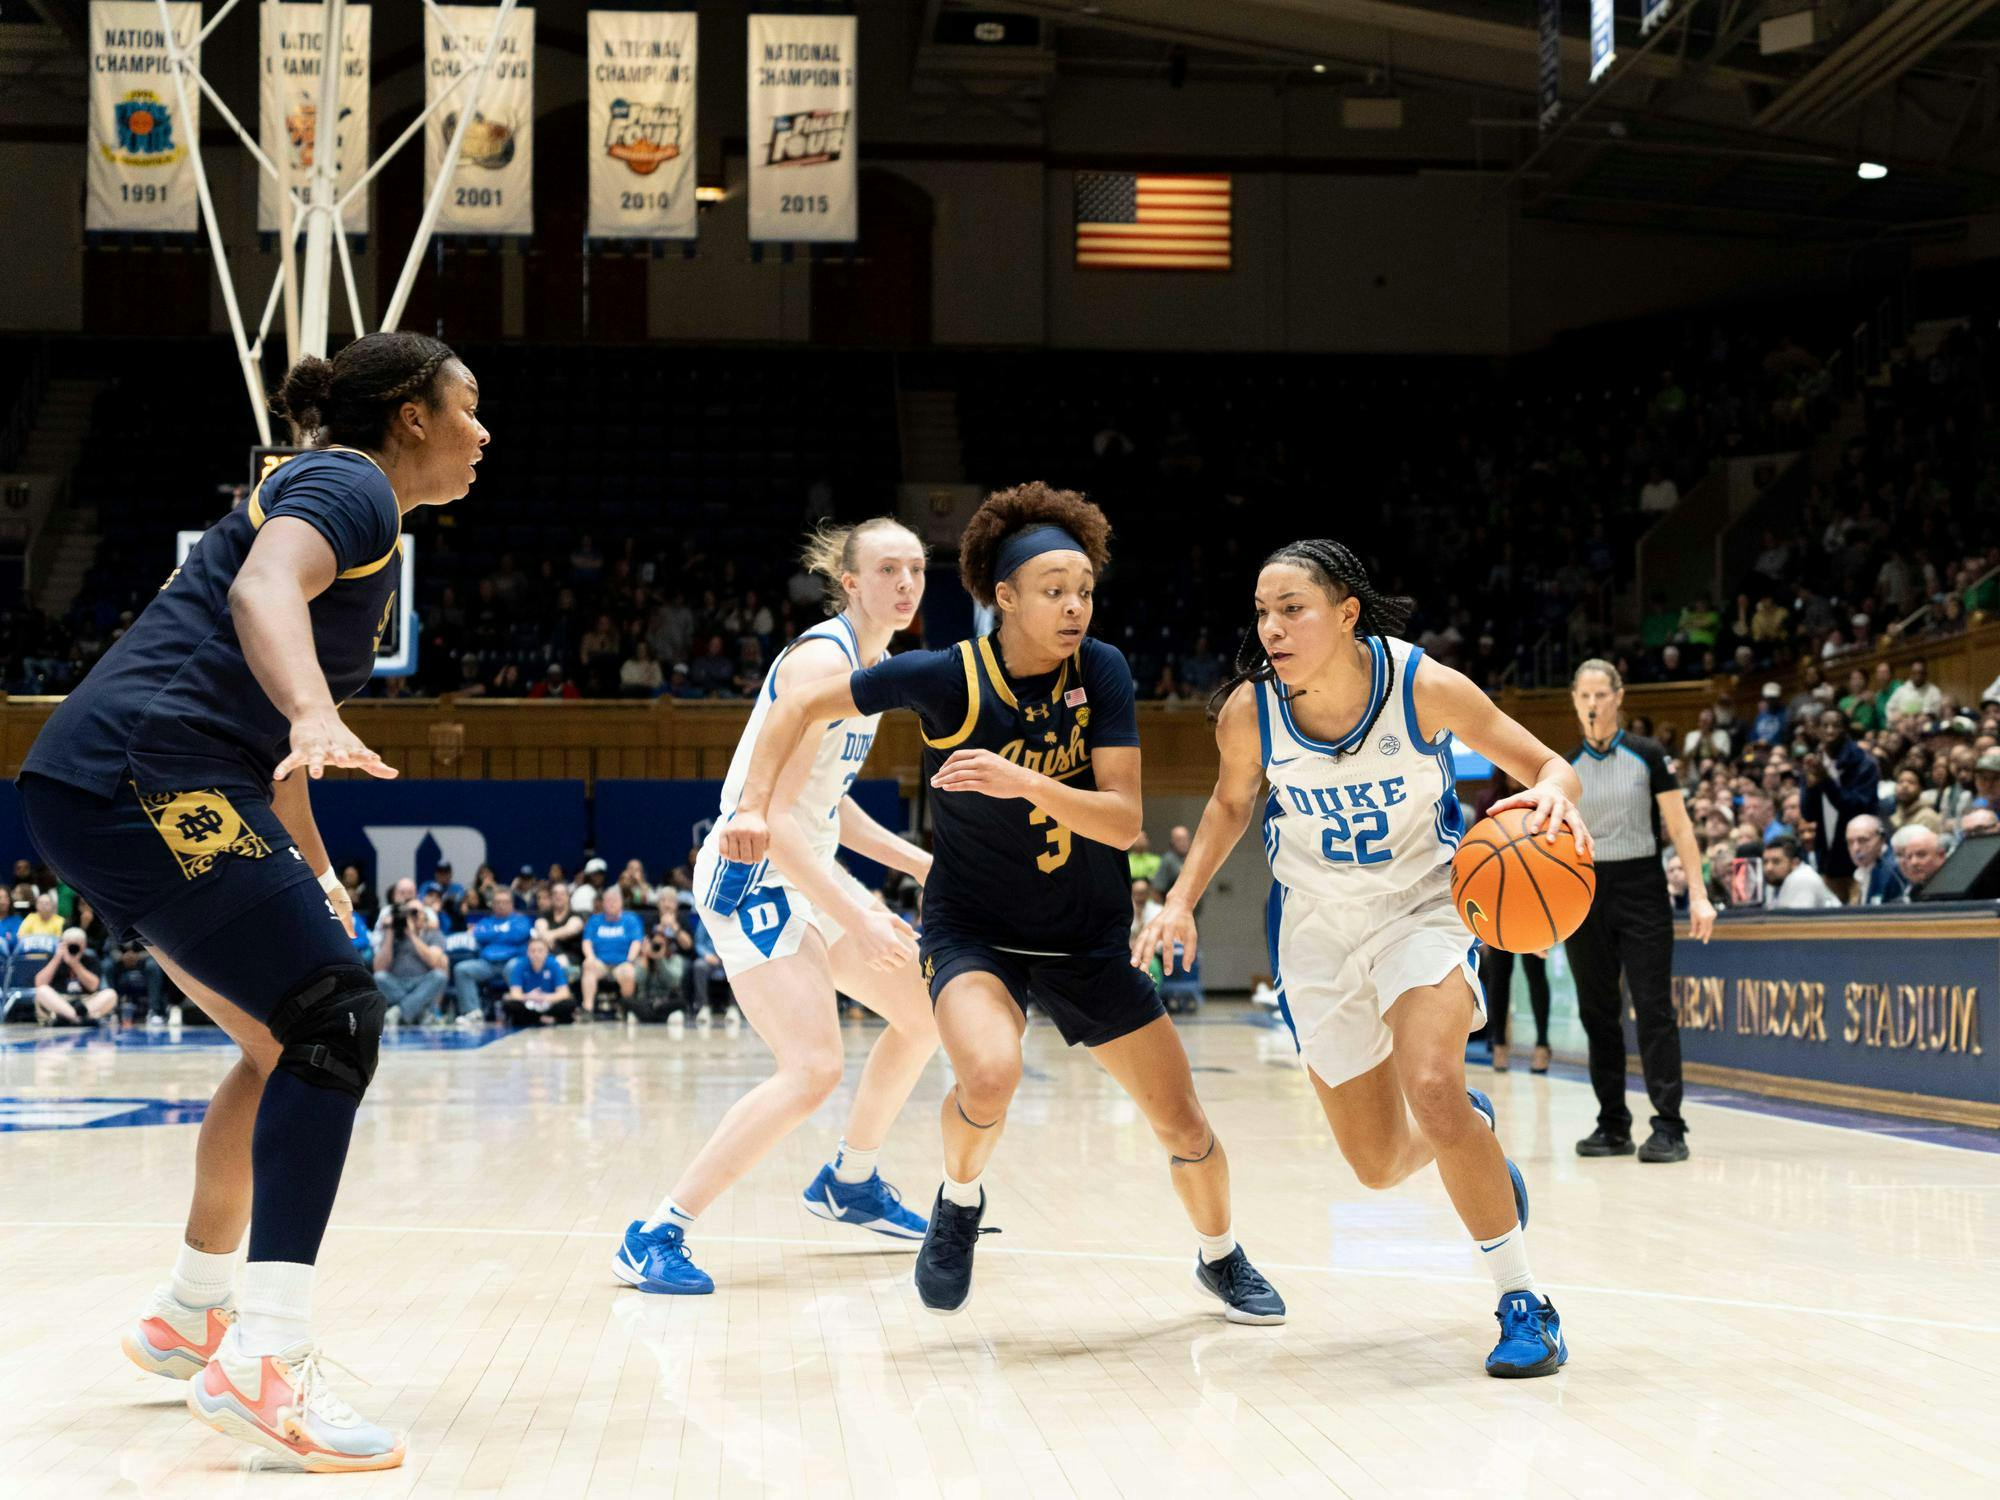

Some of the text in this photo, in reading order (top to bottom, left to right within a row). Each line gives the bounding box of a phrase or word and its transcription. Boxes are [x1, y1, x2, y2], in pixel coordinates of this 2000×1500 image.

[764, 43, 840, 62] NATIONAL
[121, 184, 168, 201] 1991
[456, 187, 503, 207] 2001
[621, 191, 670, 209] 2010
[780, 195, 828, 213] 2015
[996, 724, 1092, 780] Irish
[1286, 775, 1408, 816] DUKE
[1029, 804, 1071, 874] 3
[1321, 809, 1393, 864] 22
[747, 901, 780, 935] D
[1671, 976, 1982, 1056] ERON INDOOR STADIUM
